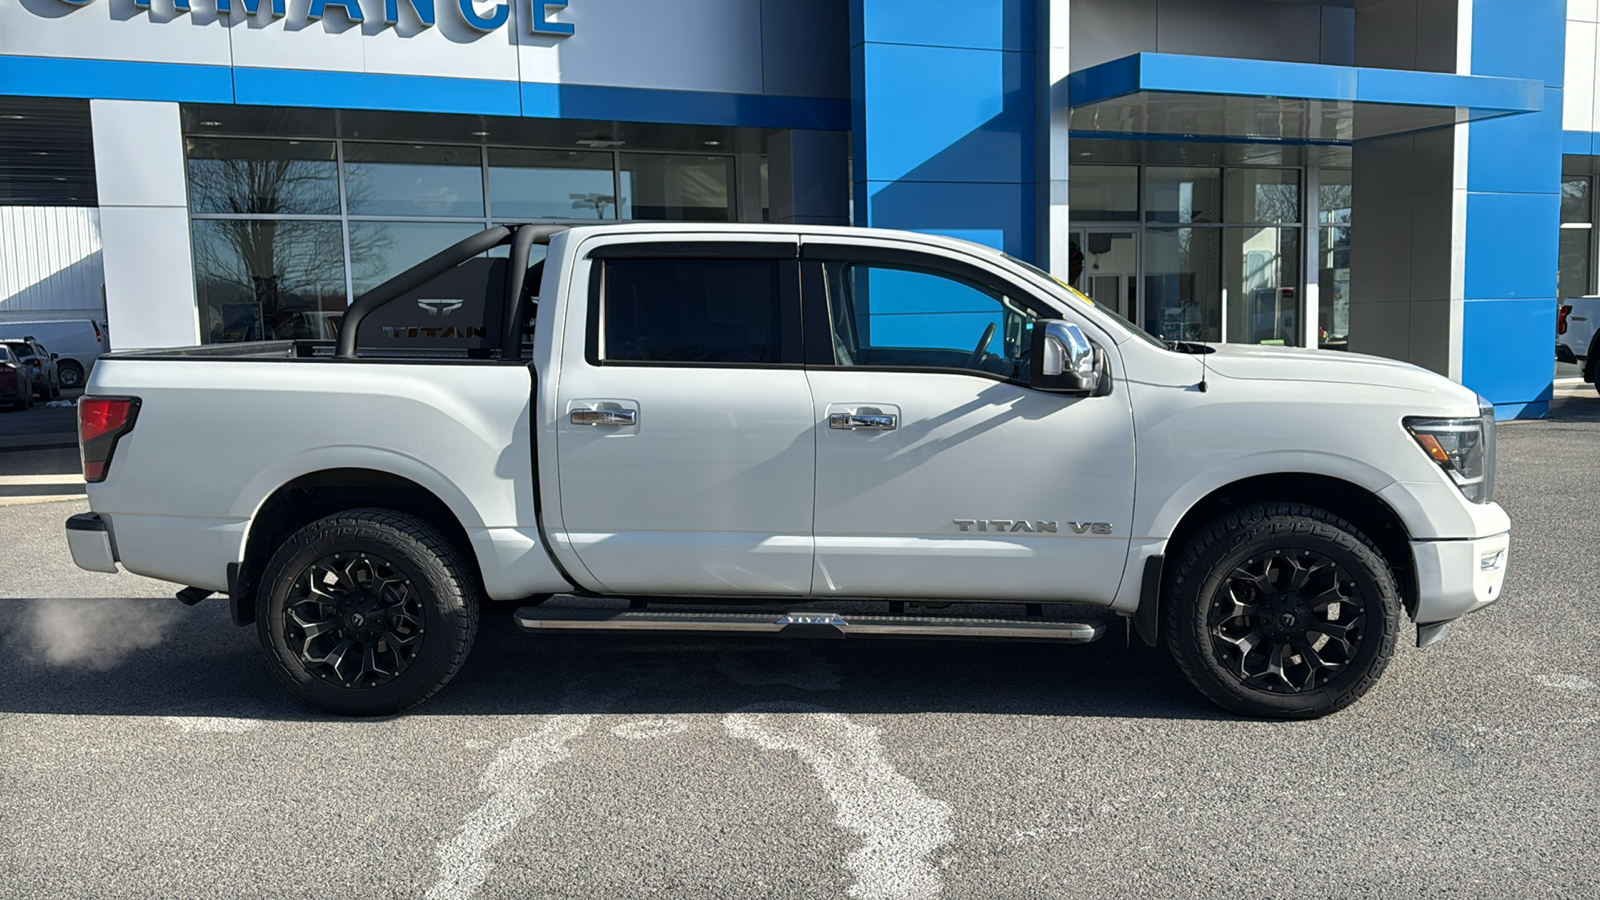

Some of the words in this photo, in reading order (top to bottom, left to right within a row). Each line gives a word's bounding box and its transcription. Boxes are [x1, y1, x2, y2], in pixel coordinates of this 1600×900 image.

[382, 326, 487, 338] TITAN
[953, 518, 1059, 533] TITAN
[1067, 521, 1113, 535] V8
